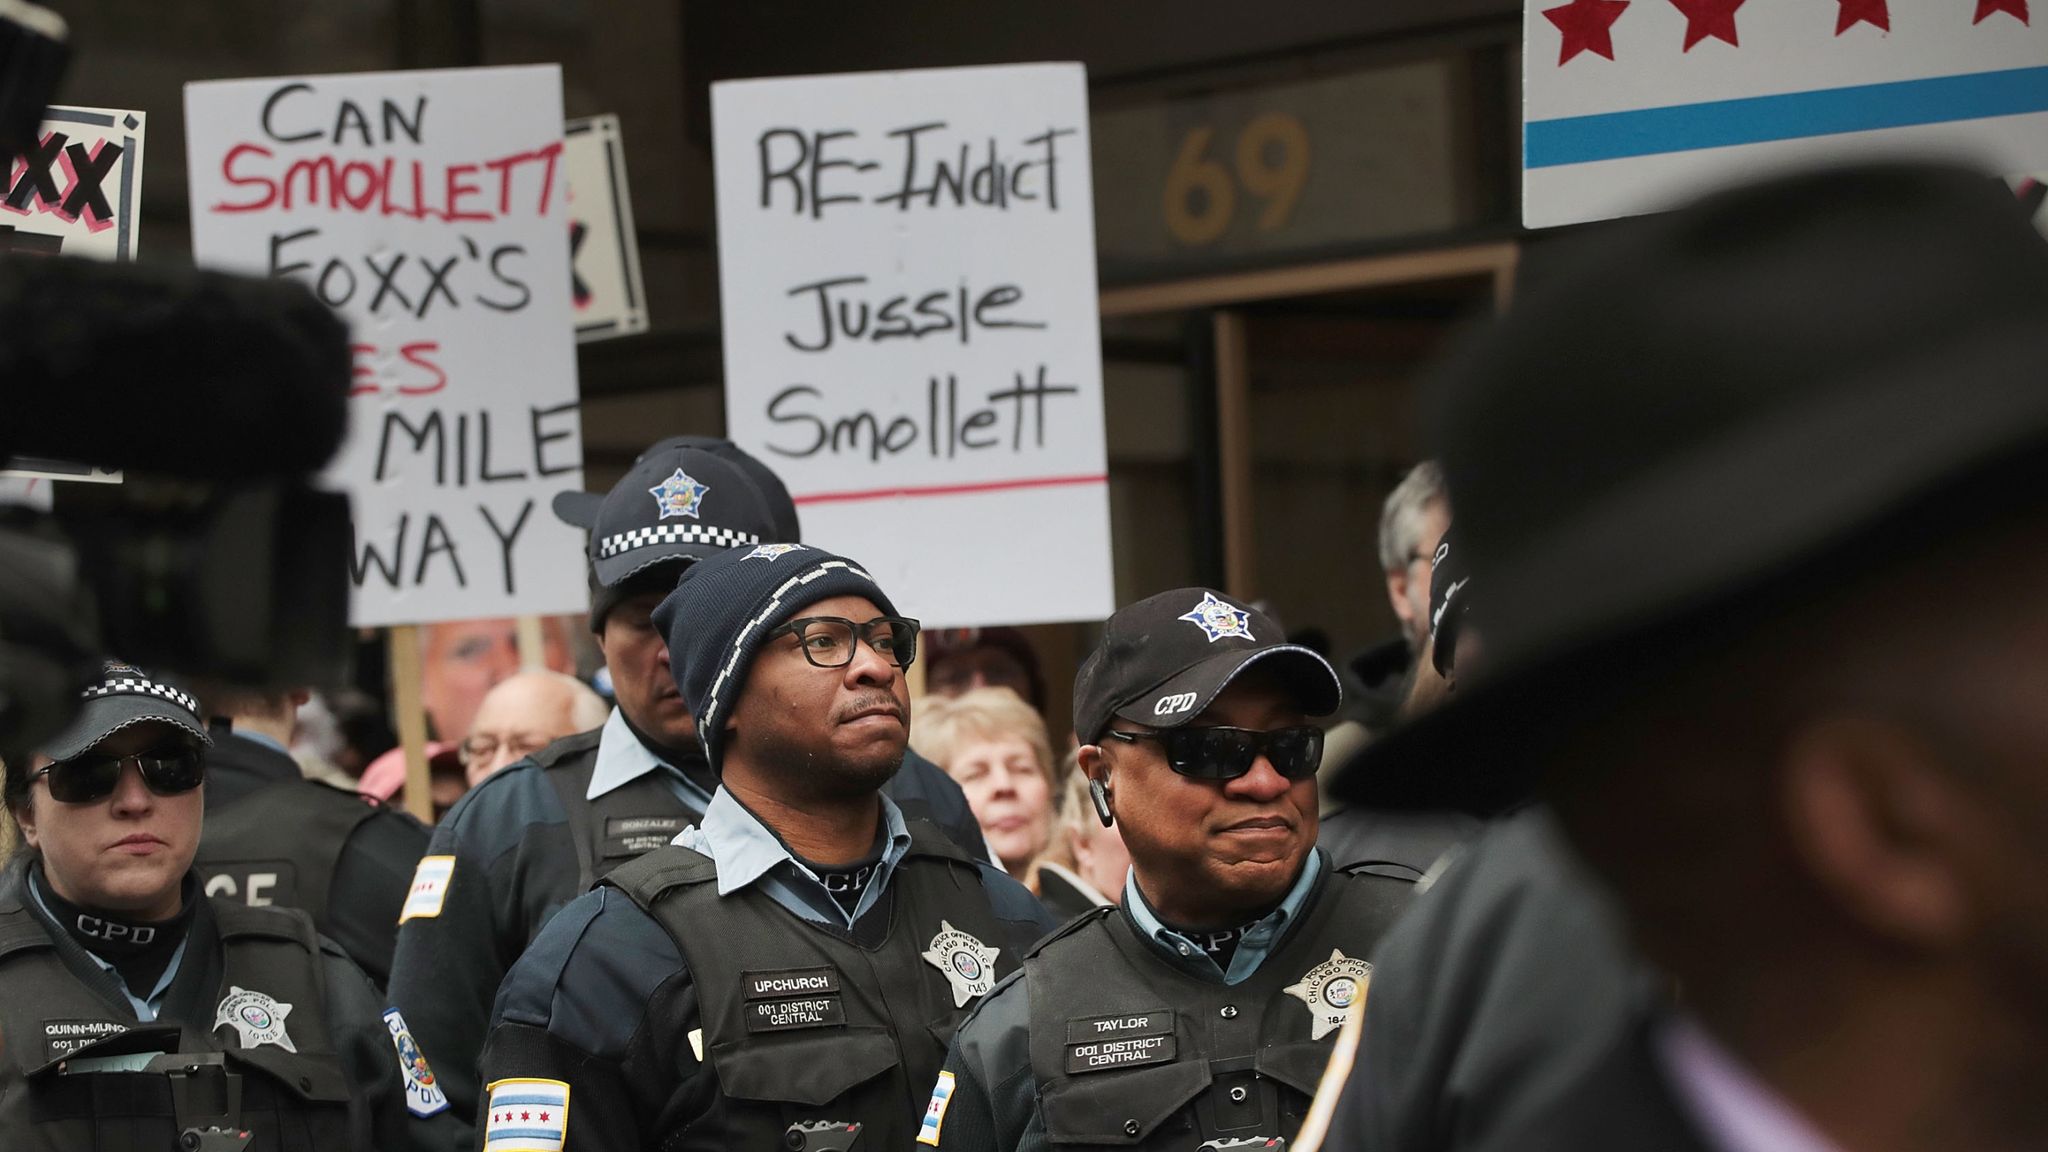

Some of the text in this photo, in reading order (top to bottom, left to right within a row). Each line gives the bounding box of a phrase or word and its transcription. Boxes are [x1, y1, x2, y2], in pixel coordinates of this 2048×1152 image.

[262, 83, 427, 147] CAN
[209, 142, 565, 222] SMOLLETT
[1164, 112, 1311, 245] 69
[269, 229, 532, 319] FOXX'S
[764, 364, 1079, 462] Smollett
[374, 402, 582, 487] MILE
[1154, 692, 1198, 716] CPD
[77, 914, 155, 945] CPD
[1305, 960, 1335, 980] POLICE
[754, 976, 829, 993] UPCHURCH
[1308, 966, 1341, 1004] CHICAGO
[758, 1000, 830, 1016] 001 DISTRICT
[770, 1011, 823, 1026] CENTRAL
[1093, 1017, 1148, 1032] TAYLOR
[52, 1040, 72, 1049] 001
[1075, 1037, 1164, 1058] 001 DISTRICT
[1089, 1049, 1151, 1066] CENTRAL
